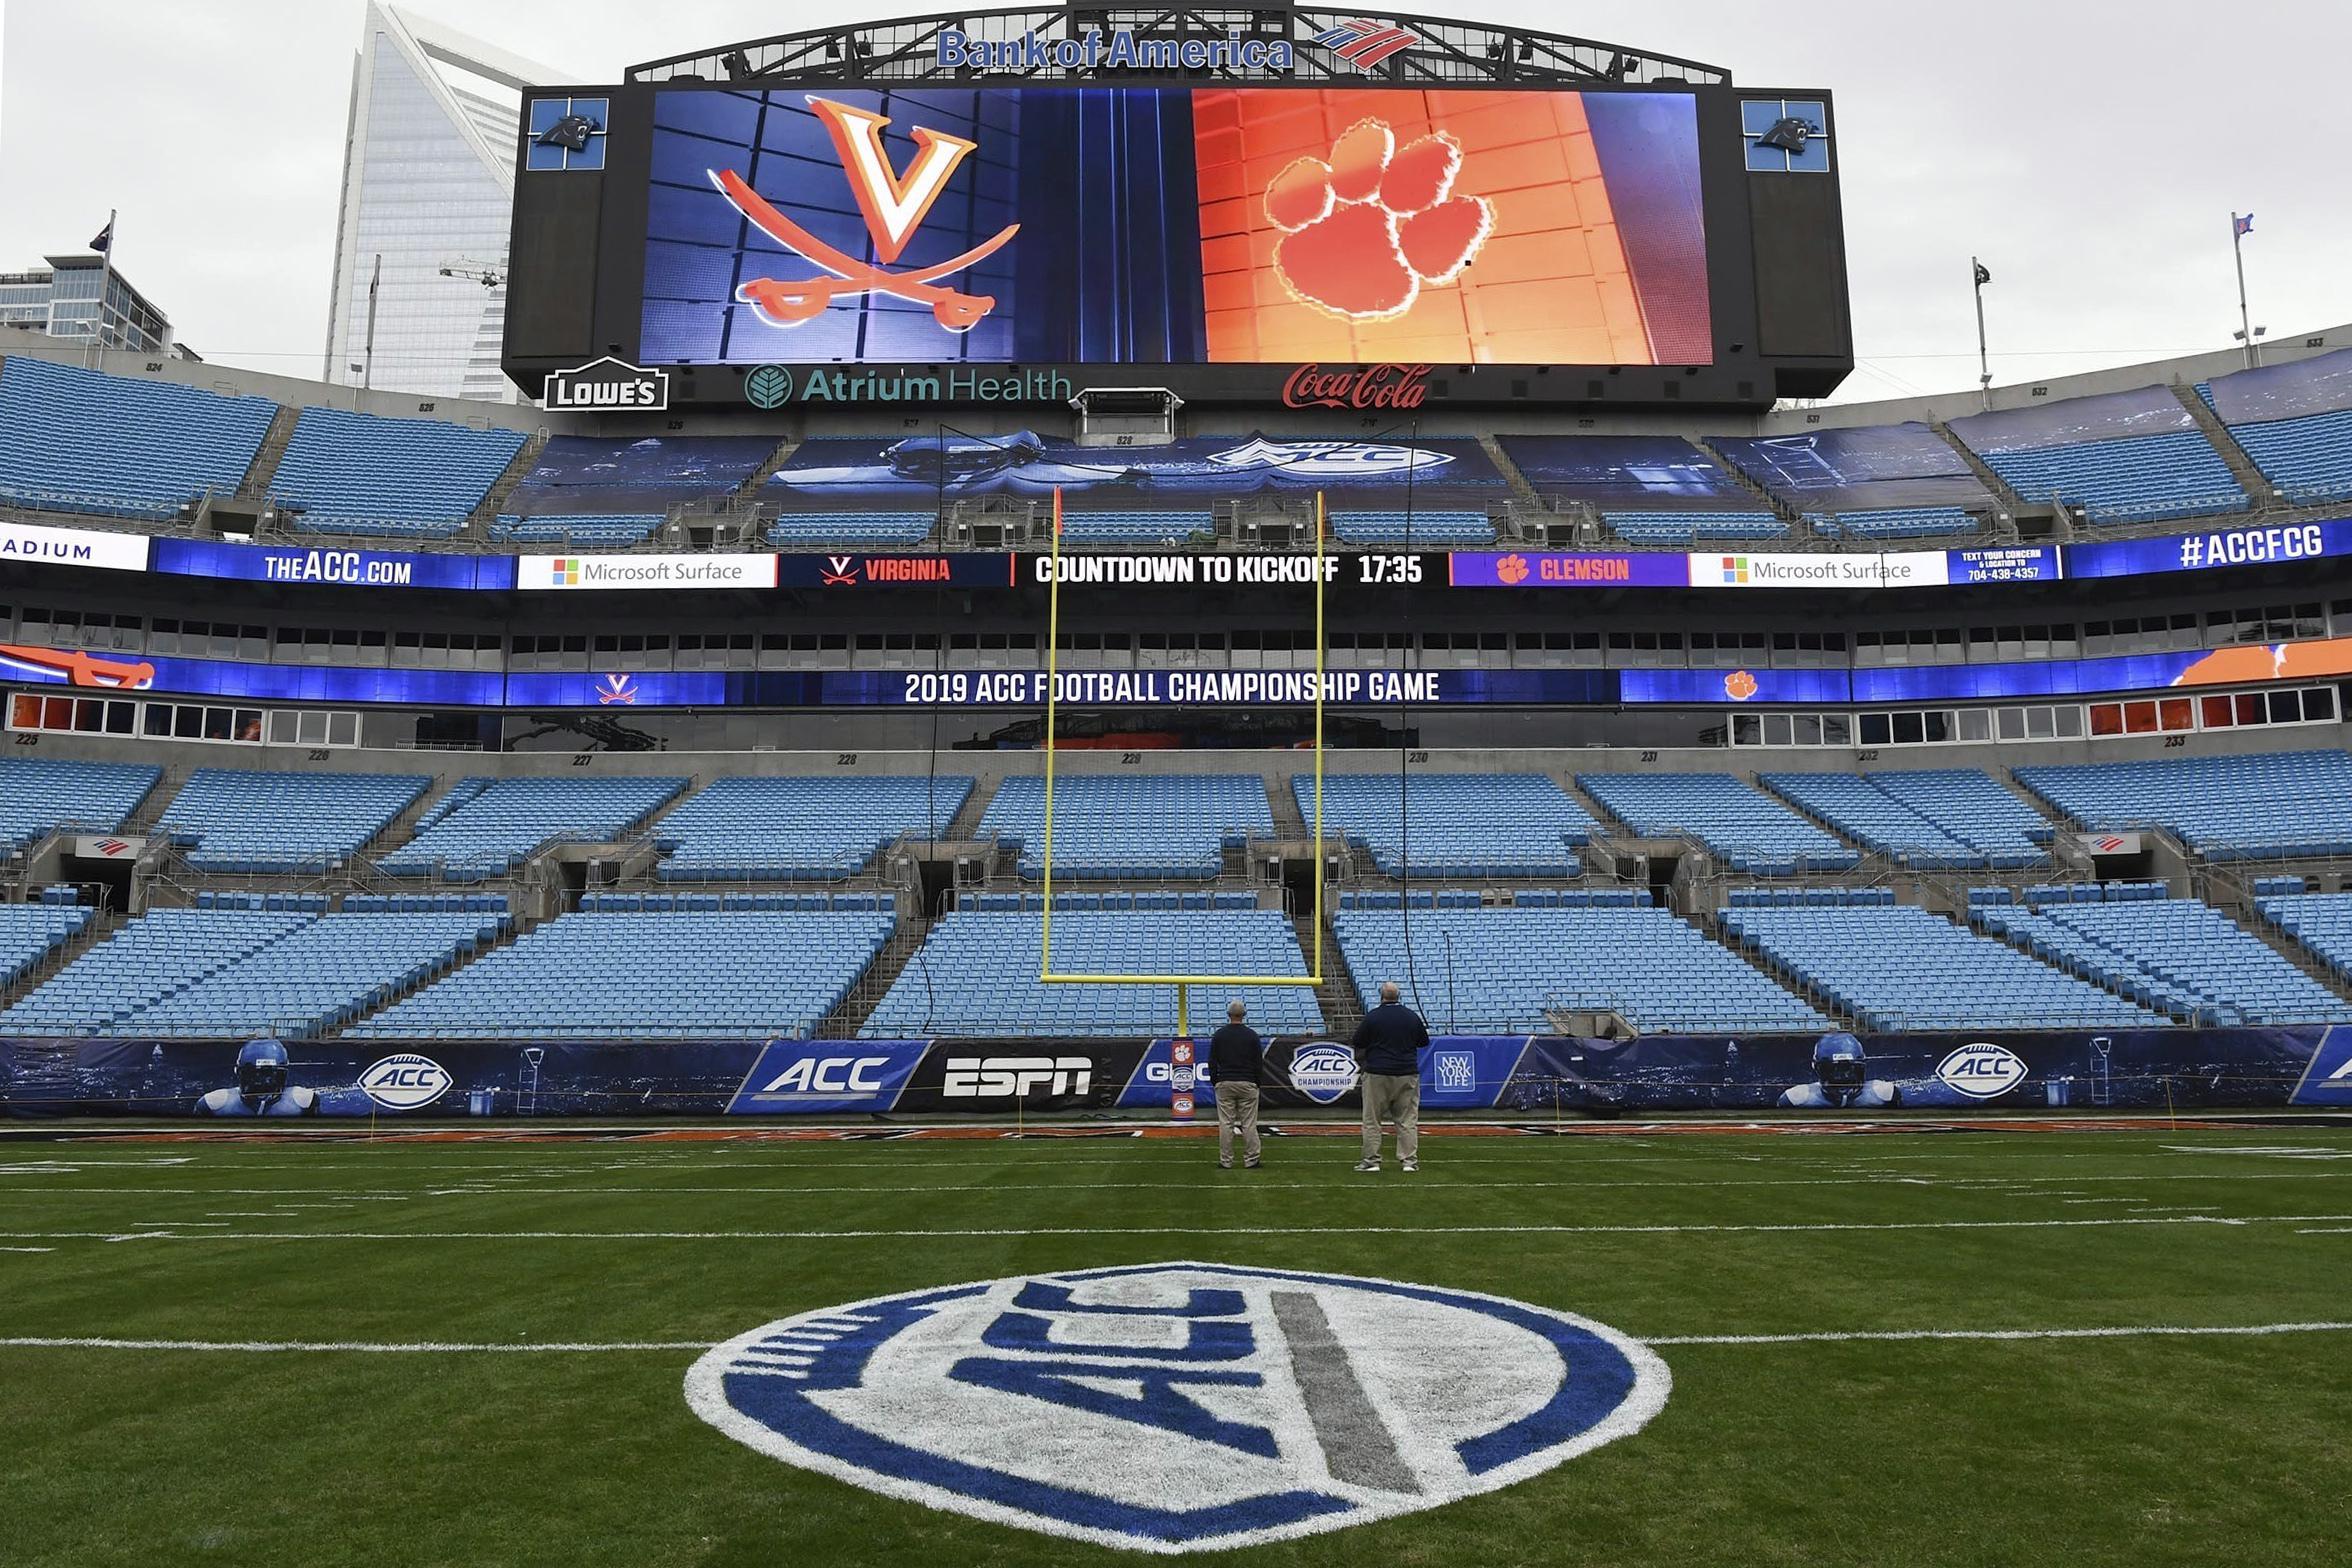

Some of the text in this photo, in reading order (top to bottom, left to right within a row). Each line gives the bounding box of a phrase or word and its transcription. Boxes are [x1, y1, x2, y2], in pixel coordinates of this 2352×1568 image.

[937, 29, 1293, 69] Bank of America
[146, 362, 162, 372] 524
[801, 369, 1072, 401] Atrium Health
[1284, 363, 1437, 408] Coca-Cola
[556, 379, 656, 406] LOWE'S
[2032, 387, 2048, 397] 532
[2180, 525, 2323, 567] #ACCFCG
[1962, 549, 2042, 561] TEXT YOUR CONCERN
[865, 559, 950, 581] VIRGINIA
[1035, 555, 1422, 583] COUNTDOWN TO KICKOFF 17:35
[1540, 559, 1630, 581] CLEMSON
[1754, 561, 1911, 579] Microsoft Surface
[1985, 560, 2016, 568] LOCATION
[2017, 559, 2026, 567] TO
[584, 562, 743, 581] Microsoft Surface
[1968, 567, 2039, 581] 704-438-4357
[905, 672, 1440, 702] 2019 ACC FOOTBALL CHAMPIONSHIP GAME
[15, 733, 38, 746] 225
[2164, 736, 2186, 748] 233
[308, 750, 330, 760] 226
[573, 755, 593, 766] 227
[837, 754, 857, 765] 228
[1121, 753, 1141, 764] 229
[1409, 752, 1429, 763] 230
[1641, 752, 1657, 762] 231
[1859, 750, 1879, 761] 232
[1302, 1059, 1348, 1072] ACC
[1442, 1056, 1468, 1067] NEW
[1952, 1058, 2012, 1076] ACC
[373, 1068, 438, 1087] ACC
[762, 1057, 890, 1092] ACC
[943, 1057, 1093, 1097] ESPN
[1146, 1062, 1211, 1081] GC
[1437, 1066, 1472, 1077] YORK
[1297, 1078, 1352, 1087] CHAMPIONSHIP
[1442, 1076, 1468, 1087] LIFE
[948, 1280, 1280, 1460] ACC
